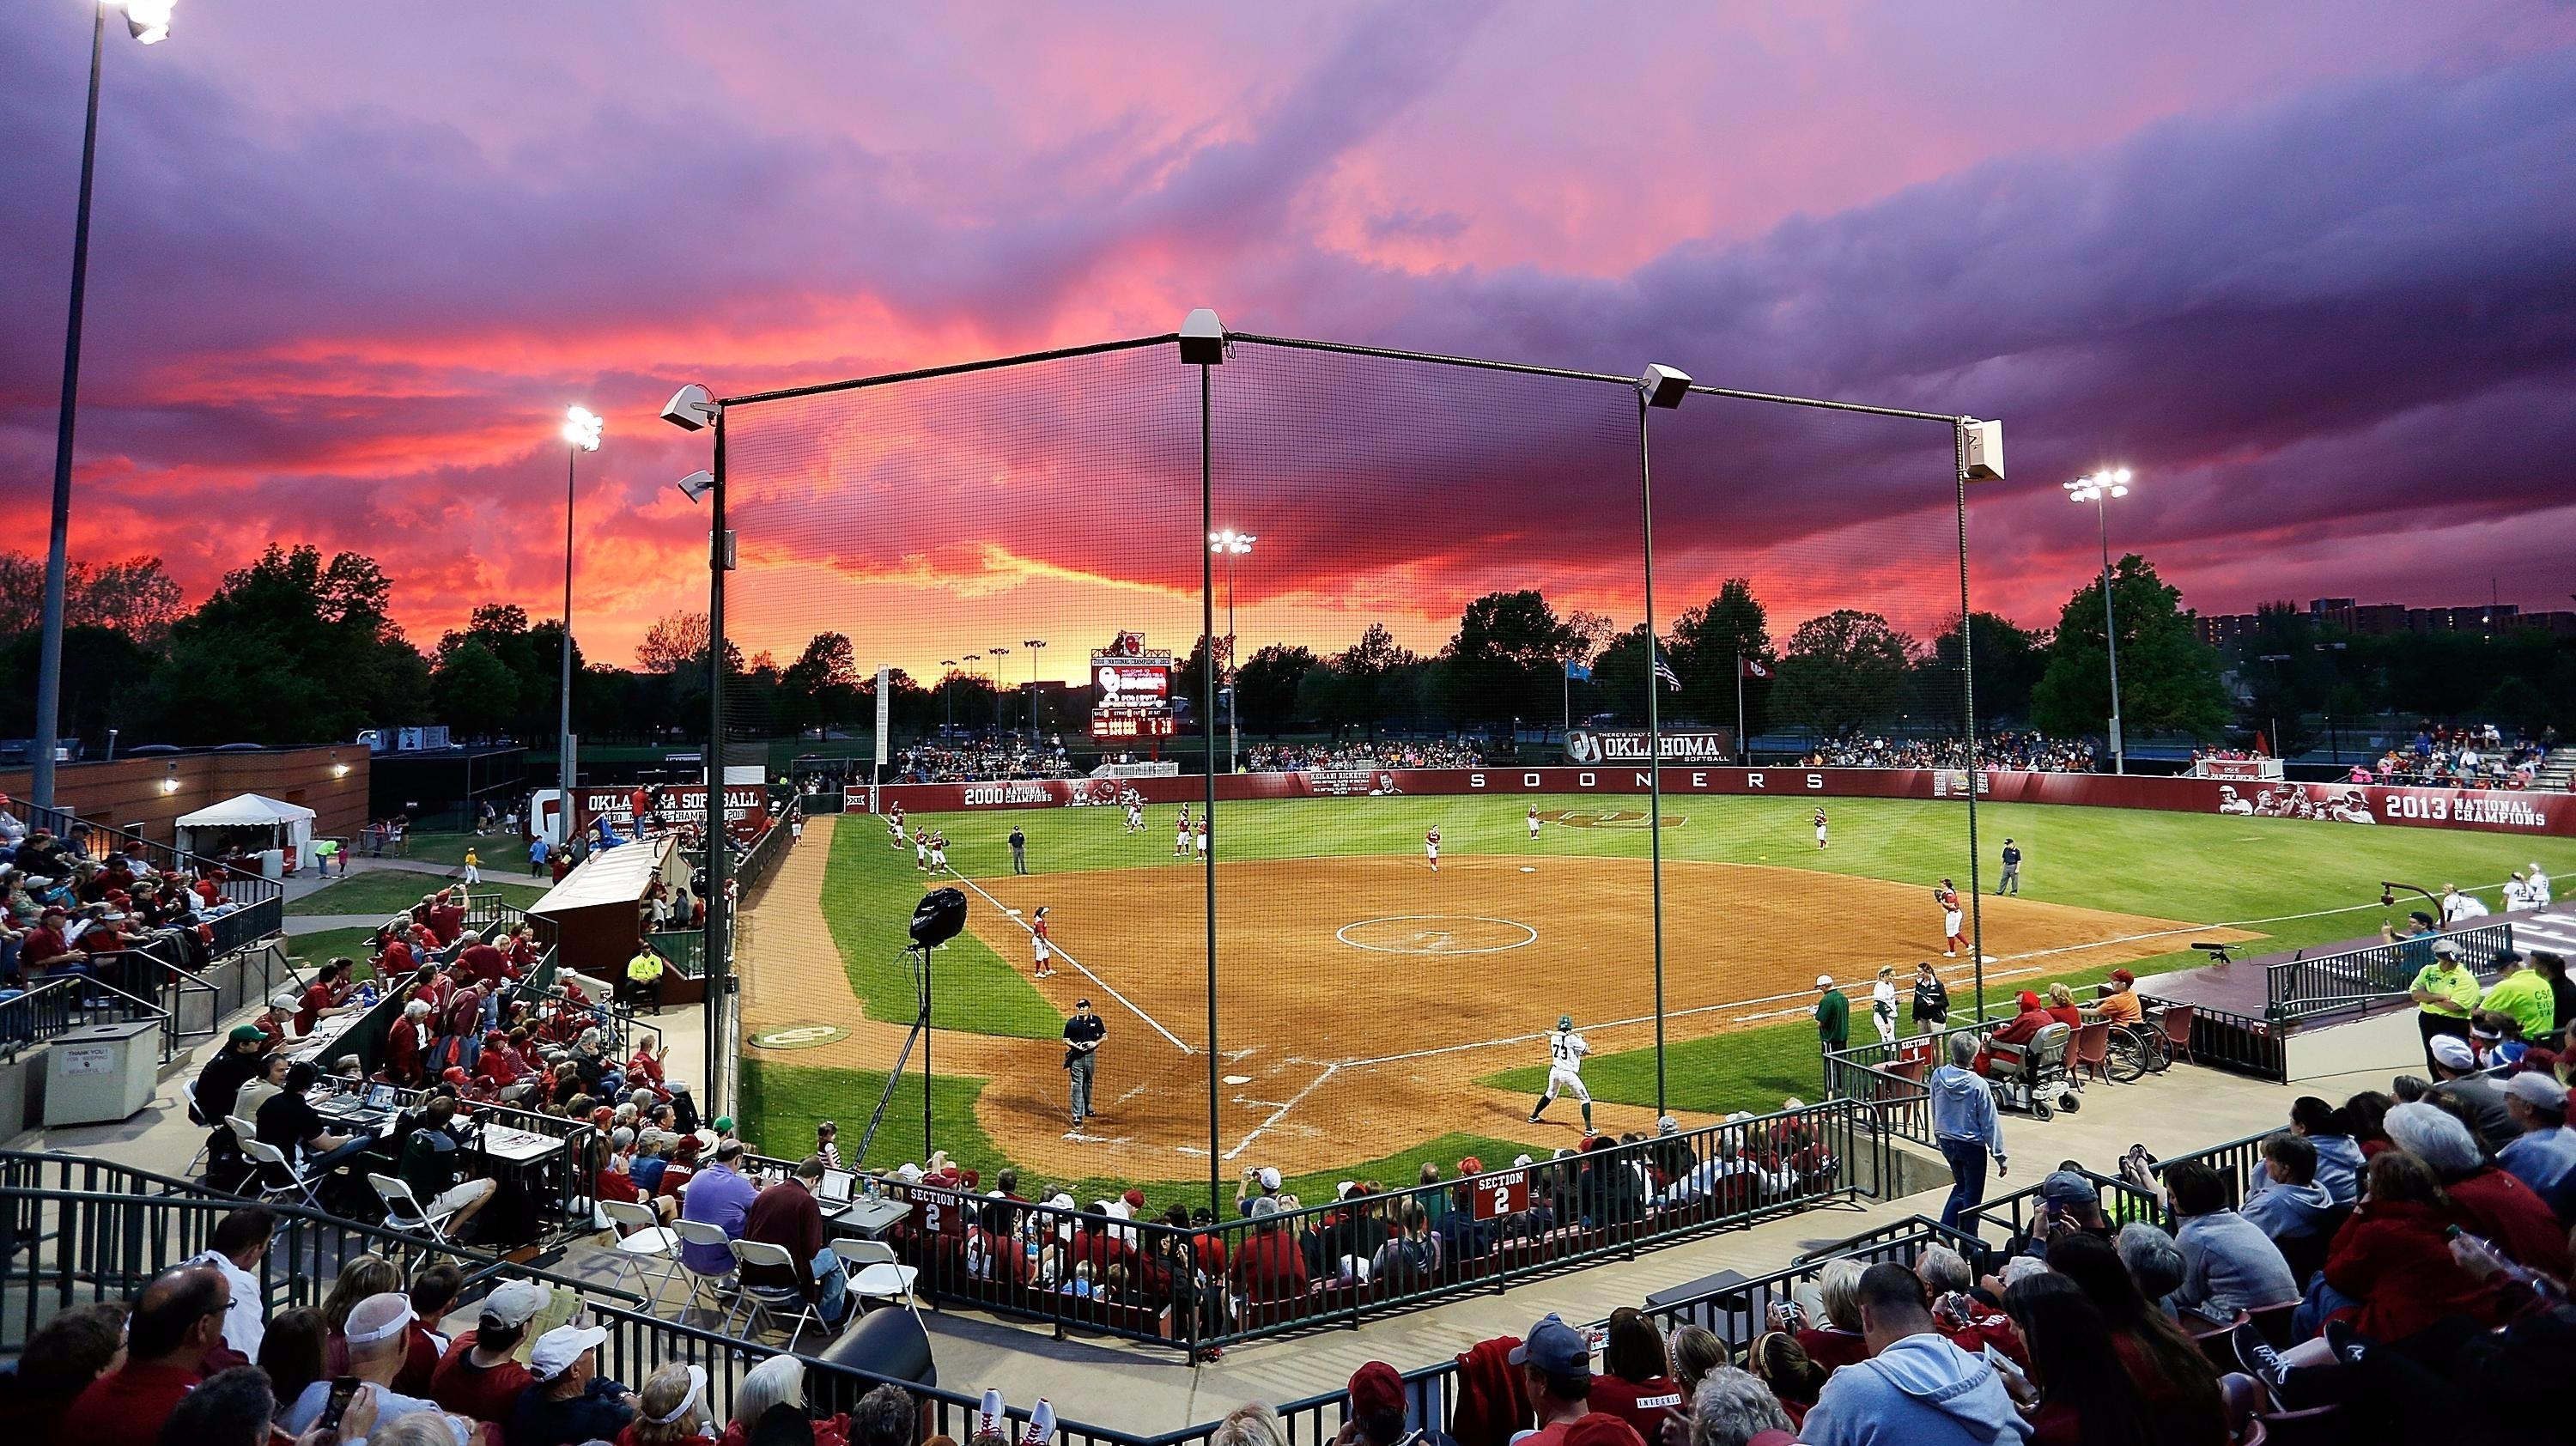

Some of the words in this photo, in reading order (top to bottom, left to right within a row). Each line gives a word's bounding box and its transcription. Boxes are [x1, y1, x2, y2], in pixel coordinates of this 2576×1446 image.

[1605, 737, 1719, 756] OKLAHOMA
[964, 787, 1003, 805] 2000
[1005, 787, 1047, 795] NATIONAL
[1005, 793, 1052, 804] CHAMPIONS
[588, 793, 677, 811] OKLAA
[682, 791, 759, 809] SOFBALL
[2385, 795, 2447, 820] 2013
[2453, 798, 2531, 813] NATIONAL
[728, 810, 744, 820] 2013
[2454, 810, 2545, 826] CHAMPIONS
[2514, 889, 2527, 897] 42
[1901, 1036, 1930, 1050] SECTION
[1913, 1048, 1919, 1060] 1
[1479, 1171, 1524, 1191] SECTION
[910, 1188, 955, 1206] SECTION
[1495, 1187, 1510, 1214] 2
[927, 1203, 940, 1230] 2
[1638, 1395, 1680, 1407] INTEGRIS
